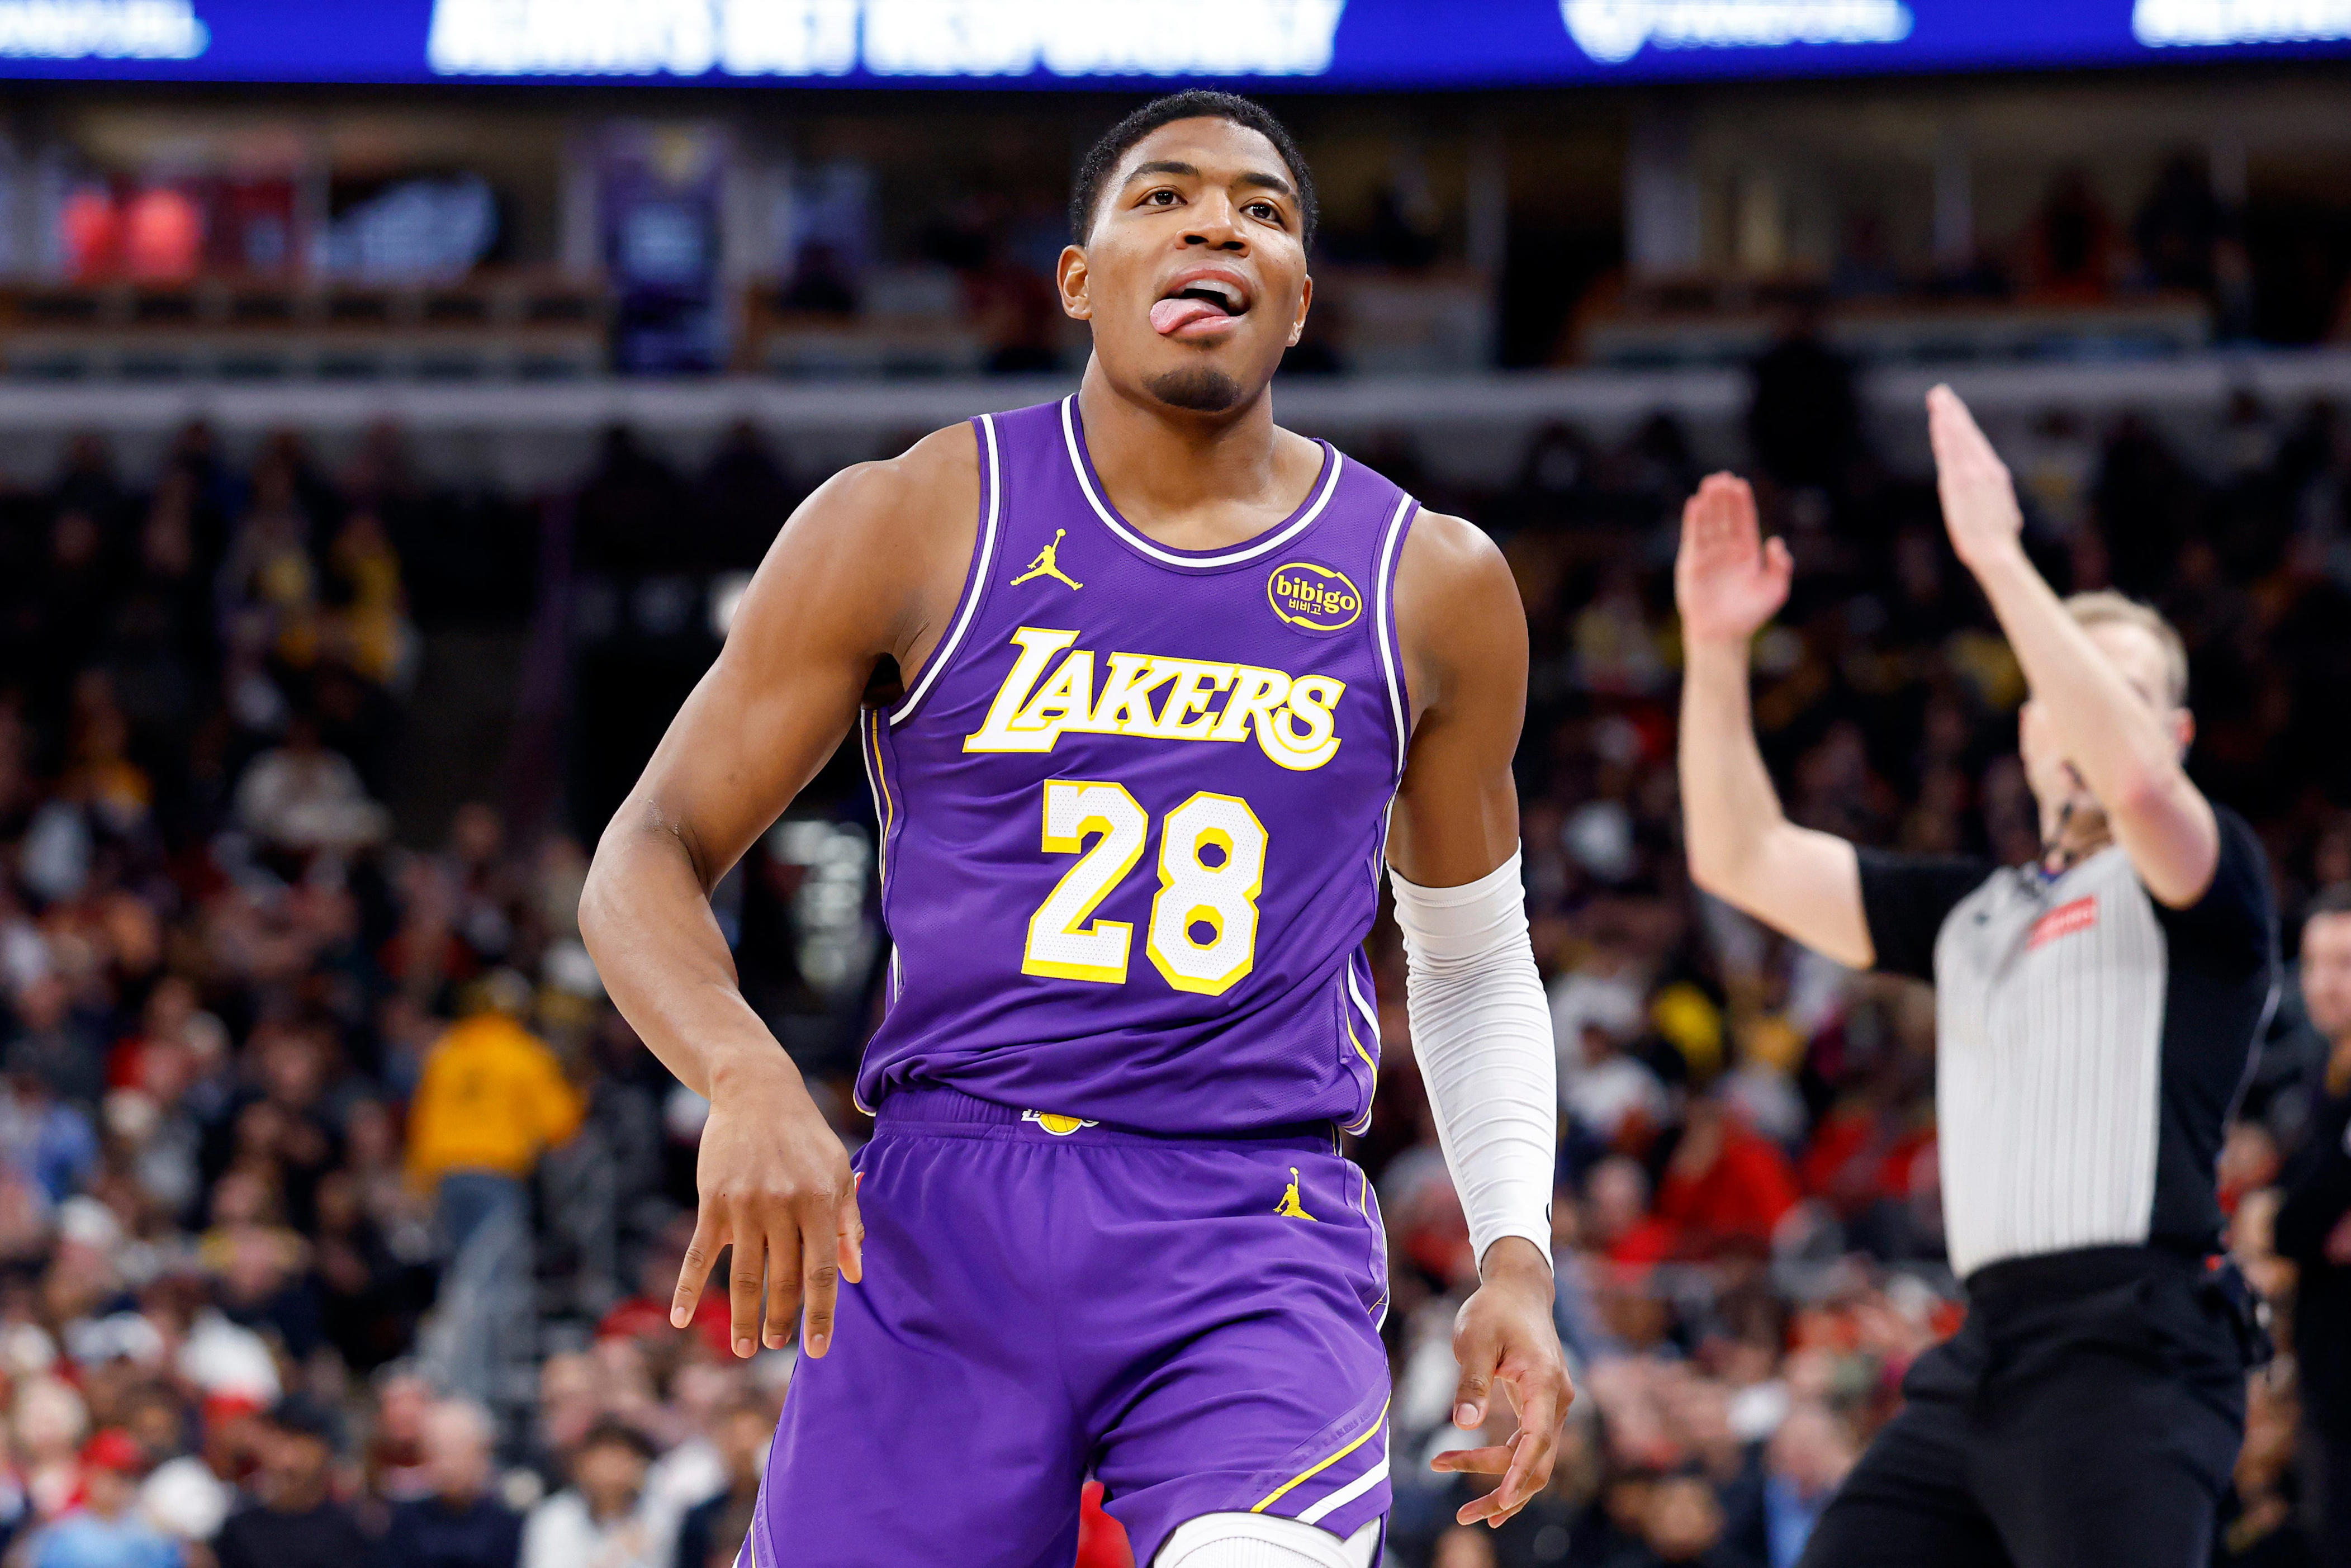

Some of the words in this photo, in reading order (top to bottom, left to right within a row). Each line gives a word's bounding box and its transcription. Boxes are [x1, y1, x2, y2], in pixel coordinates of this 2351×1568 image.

[1277, 575, 1355, 614] bibigo
[1288, 598, 1321, 615] 비비고
[962, 626, 1347, 771] LAKERS
[1021, 779, 1269, 997] 28
